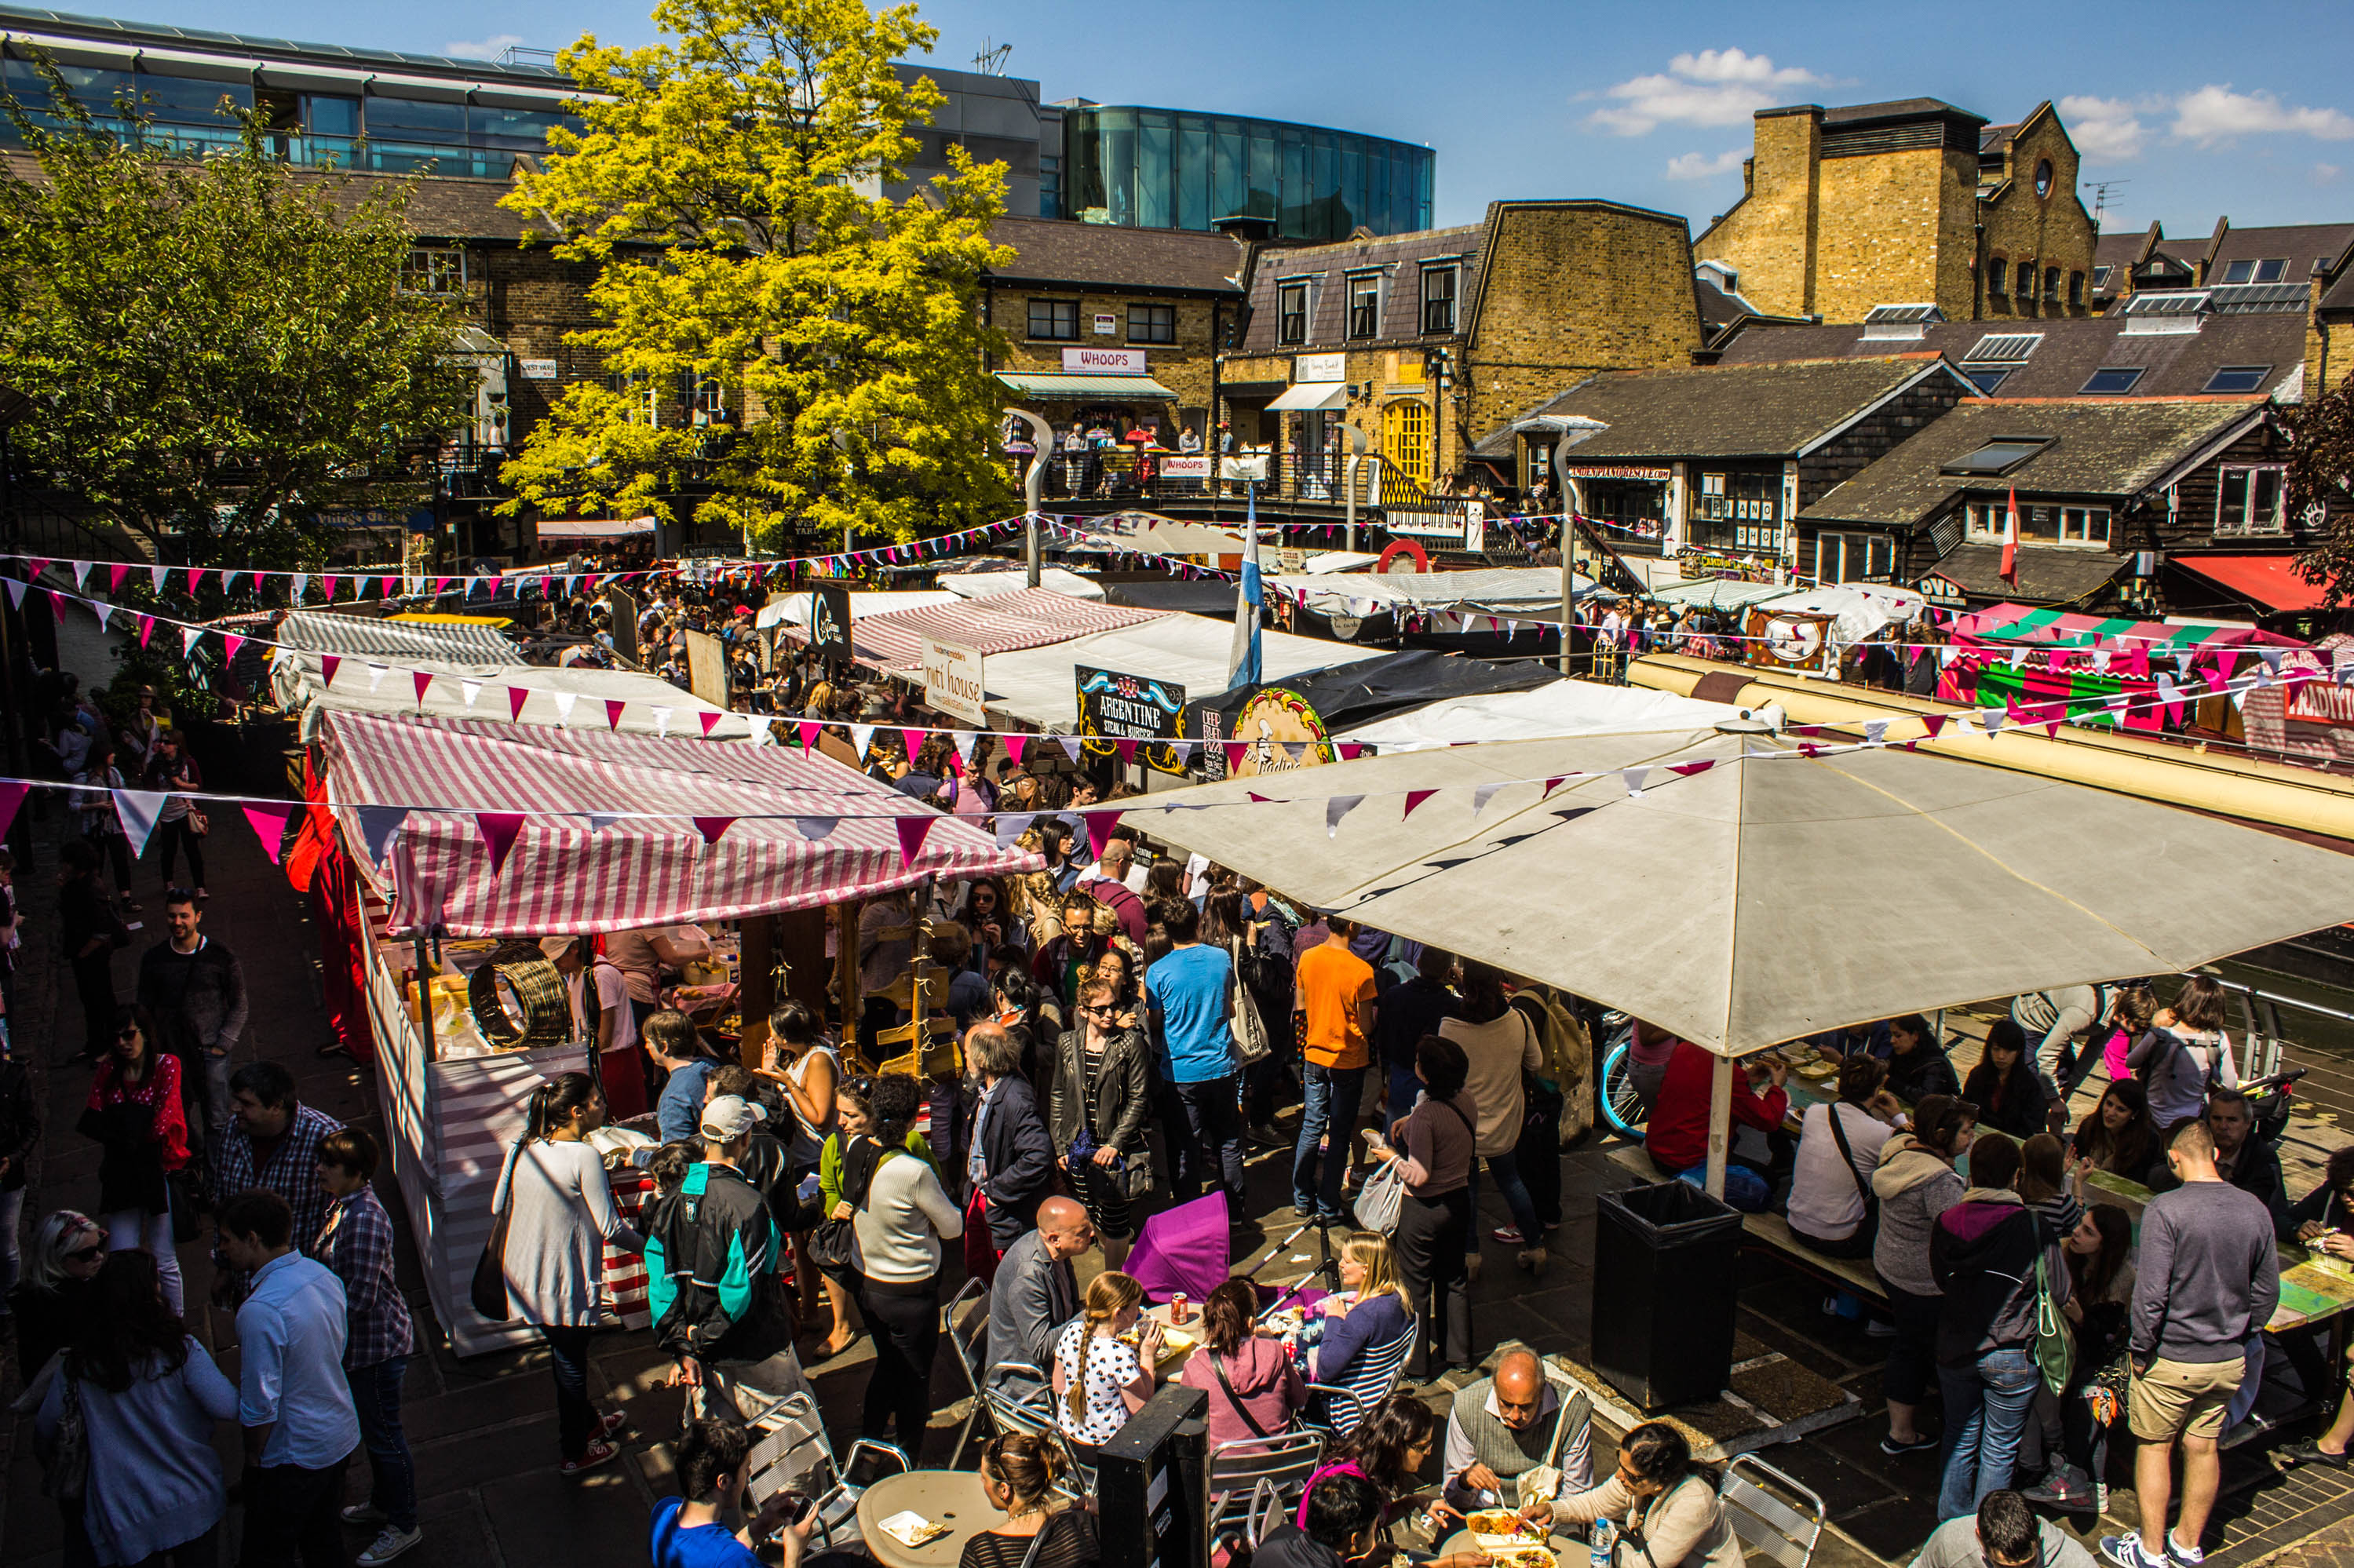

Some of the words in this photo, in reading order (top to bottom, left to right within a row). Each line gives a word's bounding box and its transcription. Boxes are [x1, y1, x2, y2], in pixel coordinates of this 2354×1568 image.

[1081, 351, 1129, 366] WHOOPS
[1168, 460, 1203, 469] WHOOPS
[1739, 530, 1780, 542] SHOP
[1920, 578, 1959, 596] DVD
[947, 660, 980, 702] house
[1100, 695, 1161, 729] ARGENTINE
[1203, 709, 1221, 727] DEEP
[1104, 720, 1120, 735] STEAK
[1120, 724, 1126, 736] &
[1127, 724, 1155, 743] BURGERS
